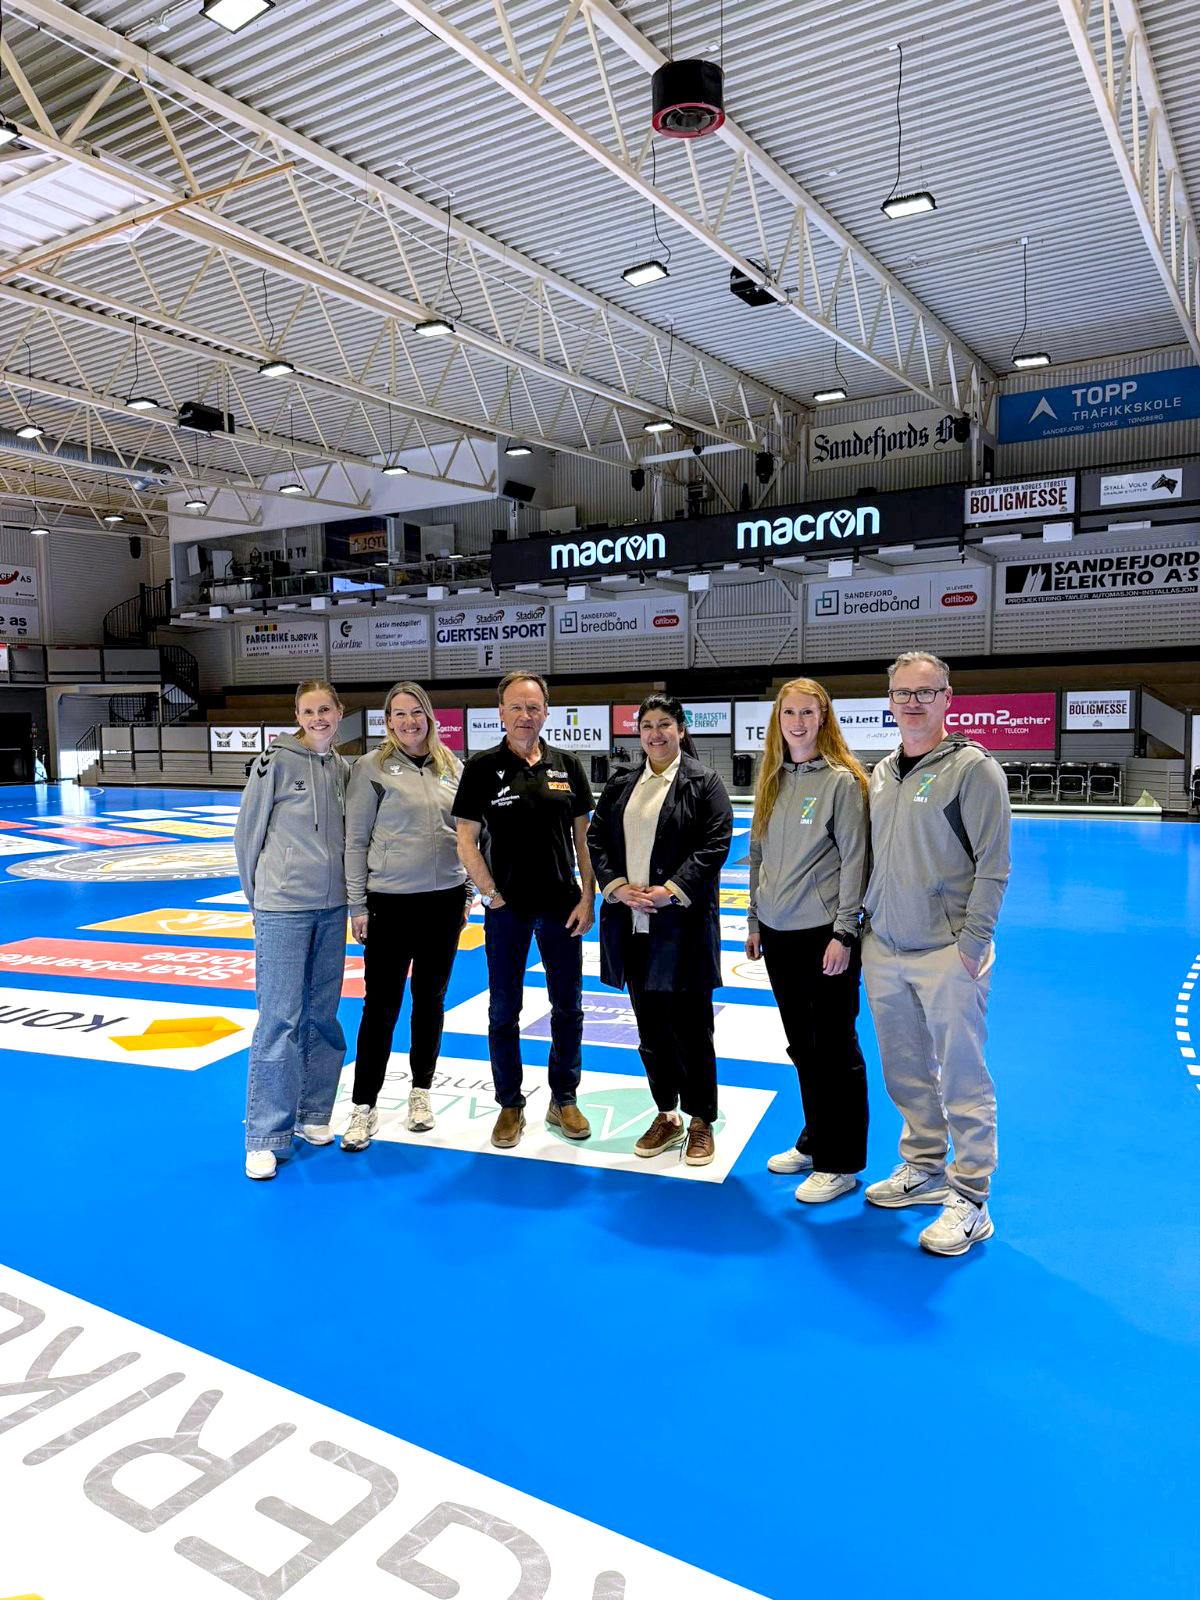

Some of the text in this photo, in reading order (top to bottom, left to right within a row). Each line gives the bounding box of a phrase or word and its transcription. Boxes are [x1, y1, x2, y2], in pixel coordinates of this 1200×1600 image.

[1071, 381, 1138, 407] TOPP
[1072, 397, 1182, 421] TRAFIKKSKOLE
[1042, 413, 1164, 436] SANDEFJORD STOKKE TØNSBERG
[812, 420, 930, 464] Sandefjords
[970, 487, 1067, 515] BOLIGMESSE
[737, 506, 880, 550] macron
[551, 532, 666, 570] macron
[1054, 551, 1200, 576] SANDEFJORD
[1054, 570, 1154, 591] ELEKTRO
[844, 589, 893, 600] SANDEFJORD
[943, 594, 975, 604] altibox
[844, 595, 920, 615] bredbånd
[9, 615, 28, 627] as
[438, 616, 463, 626] Stadion
[476, 613, 503, 624] Stadion
[516, 609, 543, 621] Stadion
[580, 611, 617, 620] SANDEFJORD
[580, 617, 637, 633] bredbånd
[246, 632, 318, 644] FARGERIKE BJØRVIK
[436, 623, 547, 644] GJERTSEN SPORT
[485, 651, 493, 666] F
[1069, 703, 1128, 715] BOLIGMESSE
[694, 712, 727, 721] BRATSETH
[694, 719, 719, 728] ENERGY
[839, 715, 854, 724] Så
[856, 716, 880, 724] Lett
[945, 709, 1051, 727] com2gether
[545, 728, 602, 741] TENDEN
[745, 726, 765, 740] TE
